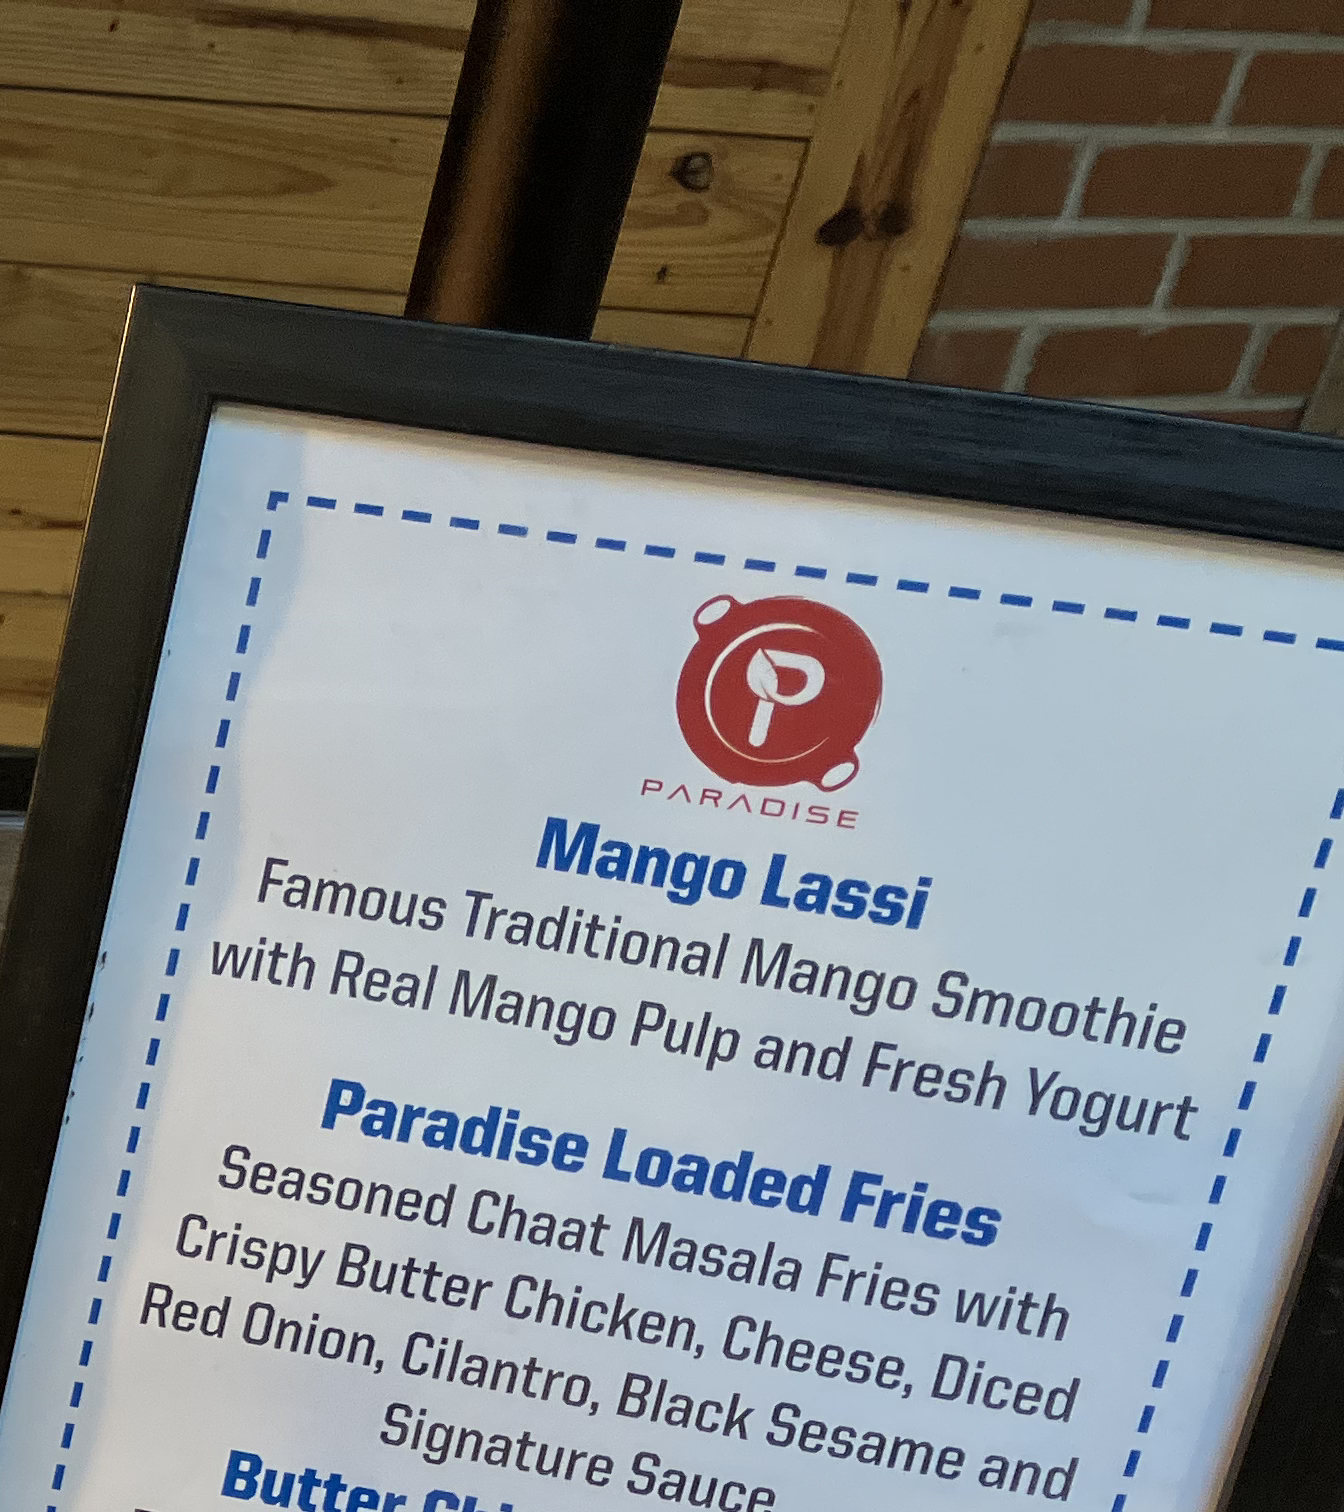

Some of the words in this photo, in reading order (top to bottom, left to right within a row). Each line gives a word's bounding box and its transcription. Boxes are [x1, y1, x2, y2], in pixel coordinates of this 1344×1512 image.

[535, 816, 748, 907] Mango
[759, 852, 934, 931] Lassi
[639, 778, 860, 830] PARADISE
[211, 936, 316, 991] with
[329, 948, 439, 1011] Real
[448, 968, 617, 1047] Mango
[630, 999, 741, 1072] Pulp
[753, 1034, 854, 1083] and
[861, 1040, 1008, 1110] Fresh
[1028, 1066, 1200, 1142] Yogurt
[257, 856, 448, 932] Famous
[465, 889, 731, 980] Traditional
[739, 936, 919, 1017] Mango
[931, 970, 1187, 1055] Smoothie
[217, 1144, 458, 1229] Seasoned
[466, 1188, 612, 1257] Chaat
[621, 1215, 803, 1293] Masala
[815, 1251, 941, 1317] Fries
[954, 1285, 1070, 1342] with
[320, 1077, 590, 1174] Paradise
[601, 1127, 832, 1217] Loaded
[839, 1169, 1002, 1248] Fries
[139, 1281, 233, 1339] Red
[242, 1301, 384, 1375] Onion,
[401, 1331, 600, 1417] Cilantro,
[615, 1371, 756, 1441] Black
[765, 1401, 966, 1481] Sesame
[978, 1454, 1080, 1502] and
[175, 1213, 327, 1290] Crispy
[335, 1241, 494, 1312] Butter
[504, 1273, 705, 1360] Chicken,
[722, 1314, 913, 1400] Cheese,
[930, 1352, 1081, 1423] Diced
[379, 1402, 615, 1487] Signature
